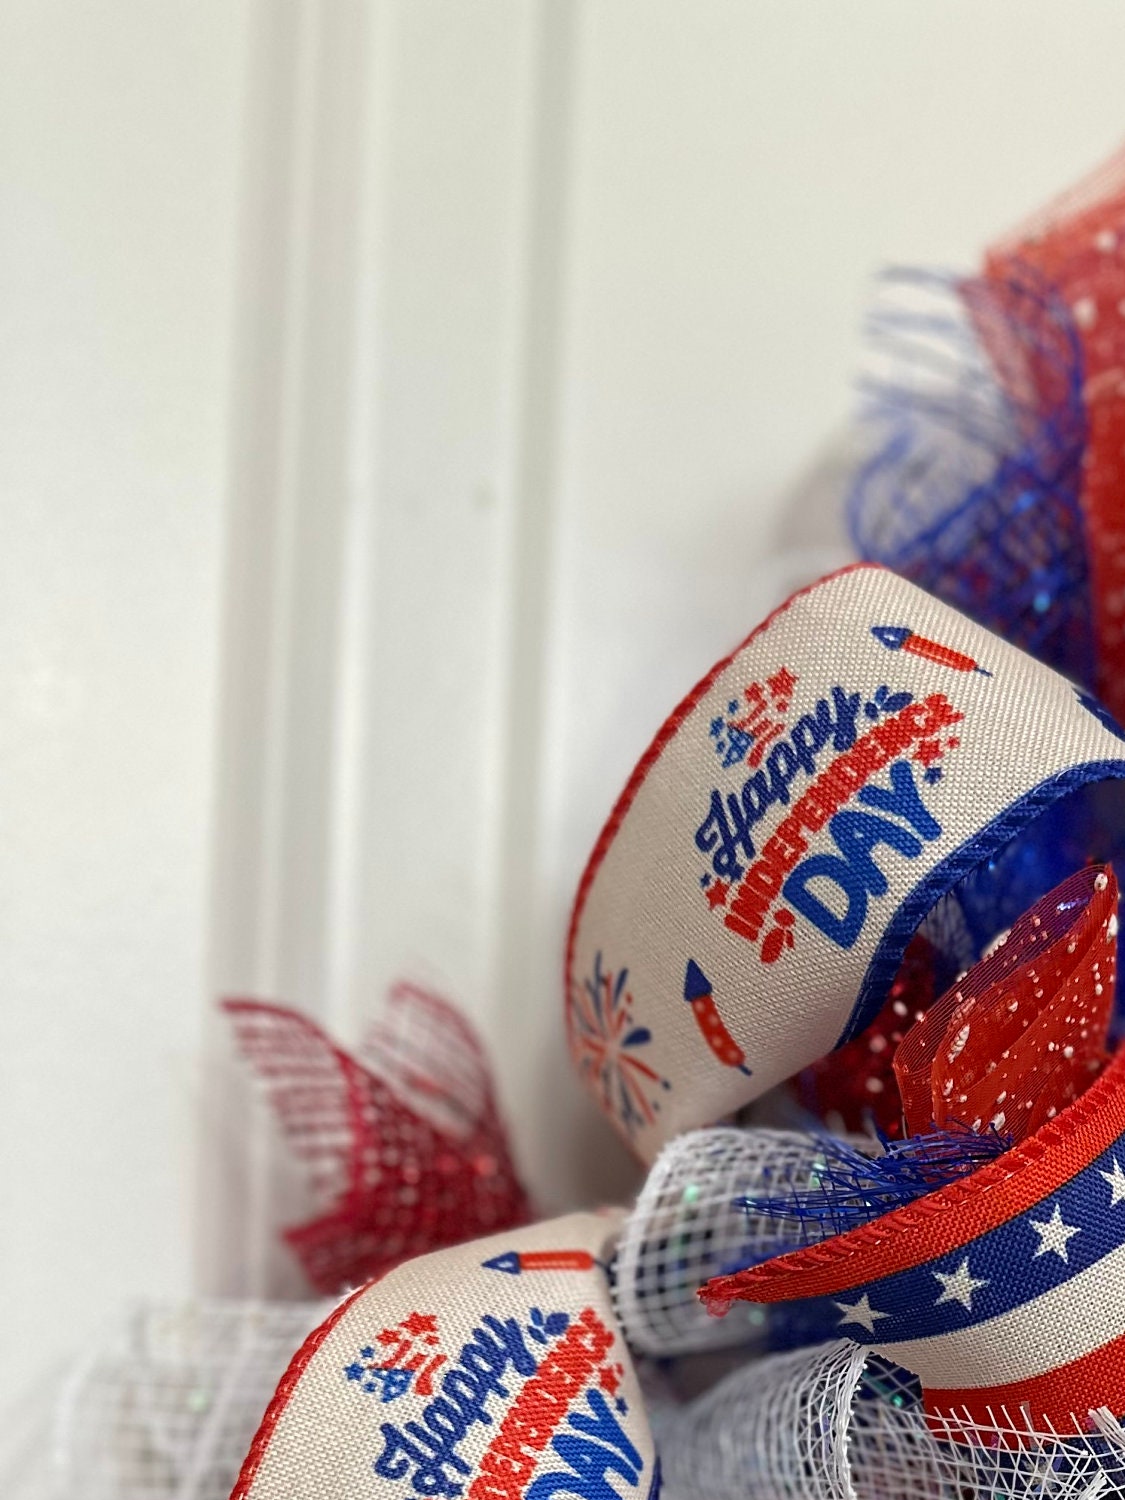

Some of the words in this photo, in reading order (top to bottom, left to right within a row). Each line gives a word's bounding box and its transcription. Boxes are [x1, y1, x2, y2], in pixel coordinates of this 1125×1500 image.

[695, 686, 862, 882] Happy
[724, 693, 964, 942] INDEPENDENCE
[782, 758, 942, 949] DAY
[374, 1314, 538, 1498] Happy
